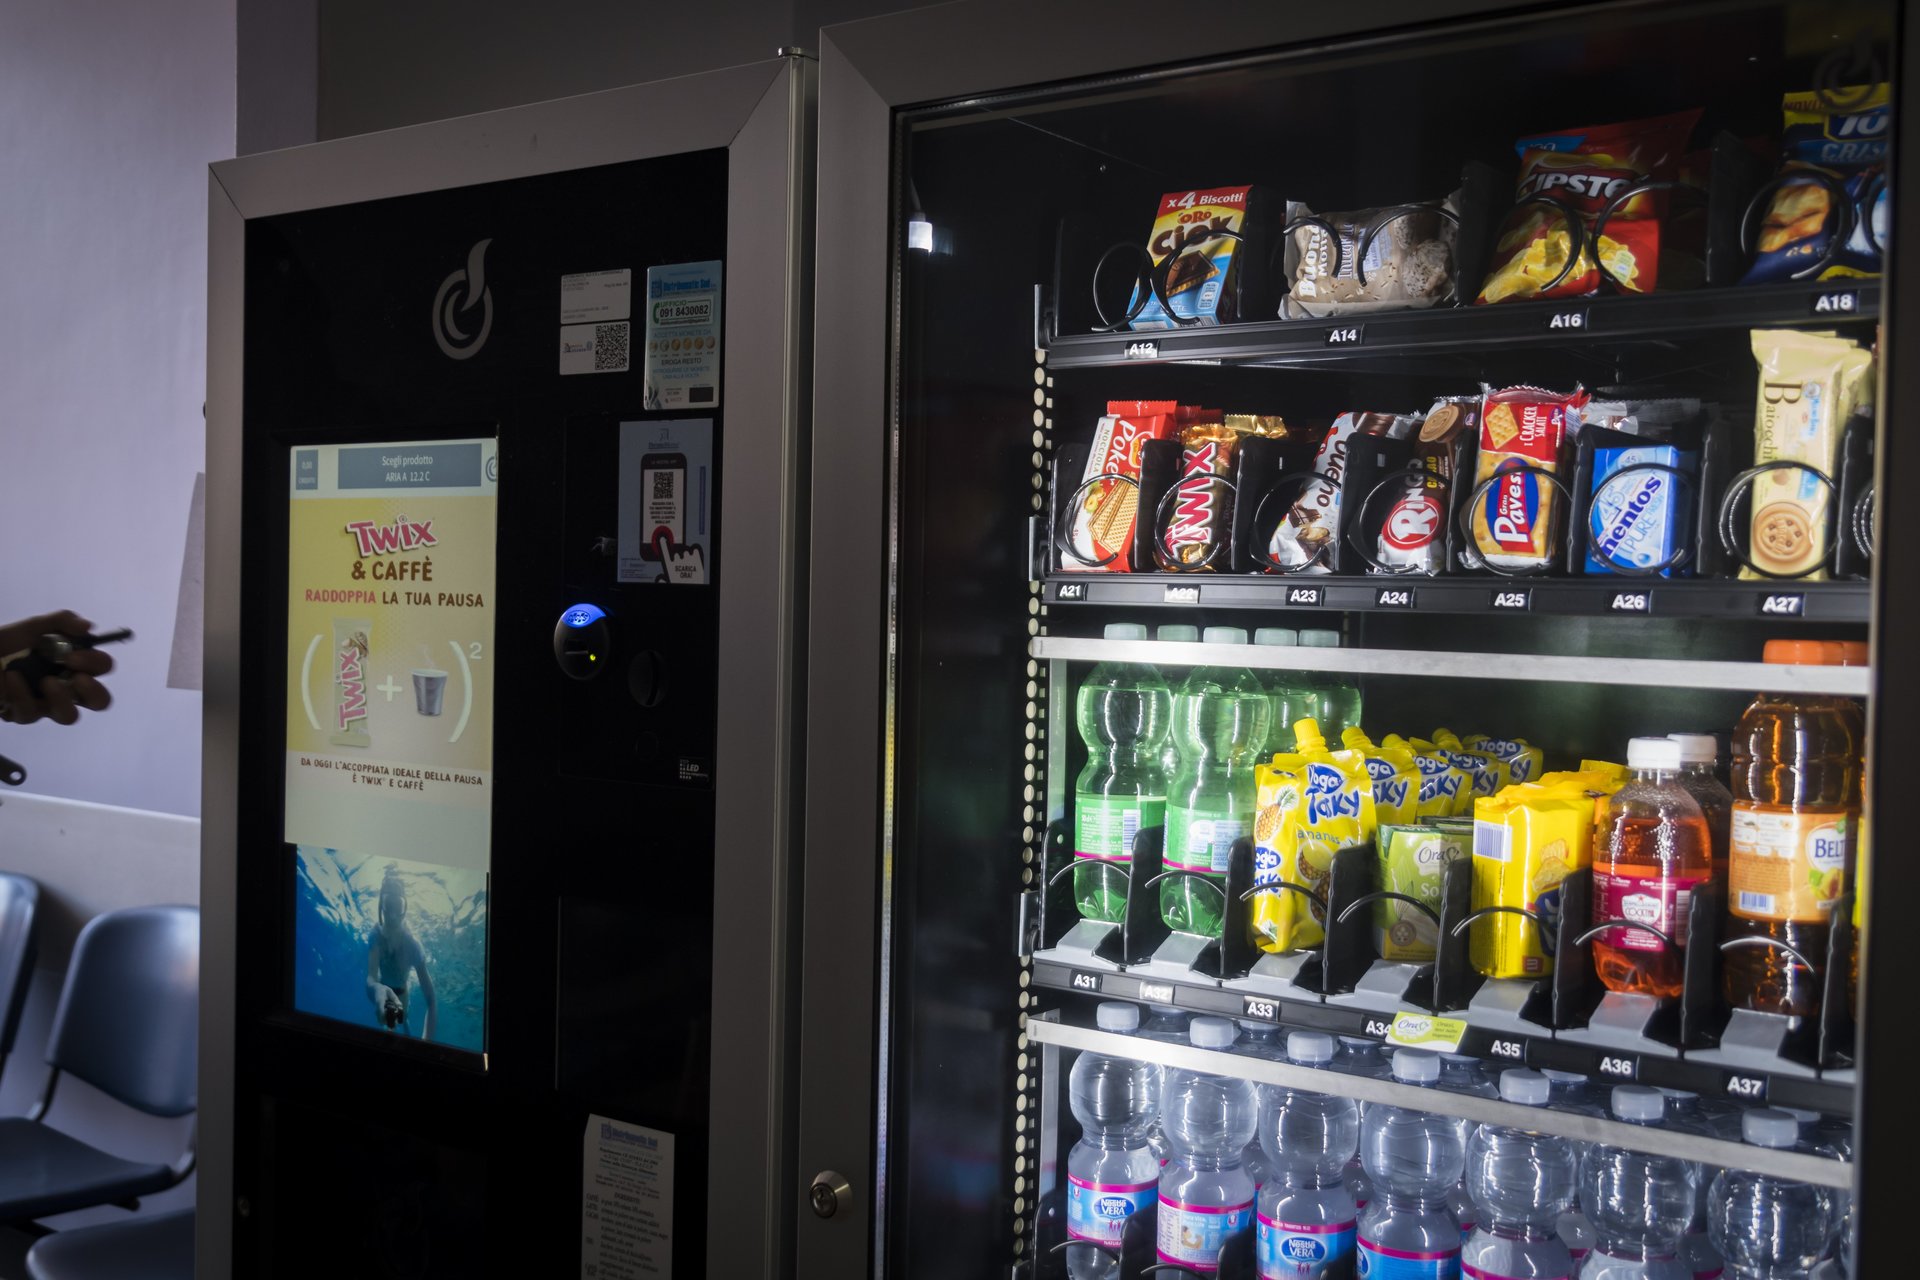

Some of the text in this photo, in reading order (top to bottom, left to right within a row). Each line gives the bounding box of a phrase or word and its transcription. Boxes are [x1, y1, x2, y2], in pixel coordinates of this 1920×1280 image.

[1168, 192, 1244, 209] x4 Biscotti
[660, 300, 687, 308] UFFICIO
[1816, 295, 1852, 311] A18
[660, 304, 709, 318] 091 8430082
[1550, 314, 1582, 328] A16
[1329, 329, 1357, 342] A14
[1129, 343, 1154, 356] A12
[1519, 406, 1537, 442] CRACKER
[1535, 416, 1547, 437] SALATI
[1763, 382, 1802, 461] Baiocchi
[1093, 429, 1111, 473] NOCCIOLA
[1106, 419, 1137, 486] Poker
[382, 455, 433, 467] Scegli prodotto
[385, 472, 401, 482] ARIA
[1426, 456, 1437, 489] CAAO
[1499, 495, 1508, 515] Gran
[1600, 477, 1662, 558] mentos
[351, 556, 433, 581] & CAFFÈ
[305, 589, 484, 608] RADDOPPIA LA TUA PAUSA
[1060, 584, 1082, 598] A21
[1290, 588, 1317, 603] A23
[1380, 591, 1408, 605] A24
[1494, 594, 1525, 607] A25
[1612, 595, 1645, 609] A26
[1762, 596, 1799, 612] A27
[301, 757, 483, 786] DA OGGI L'ACCOPPIATA IDEALE DELLA PAUSA
[686, 764, 699, 772] LED
[1415, 757, 1448, 772] oga
[389, 779, 394, 788] E
[397, 779, 424, 791] CAFFÈ
[1297, 829, 1340, 844] ananas
[1074, 974, 1096, 988] A31
[1248, 1002, 1272, 1017] A33
[1491, 1040, 1520, 1056] A35
[1600, 1057, 1632, 1074] A36
[1727, 1077, 1762, 1095] A37
[1102, 1206, 1125, 1215] VERA
[1290, 1247, 1314, 1258] VERA
